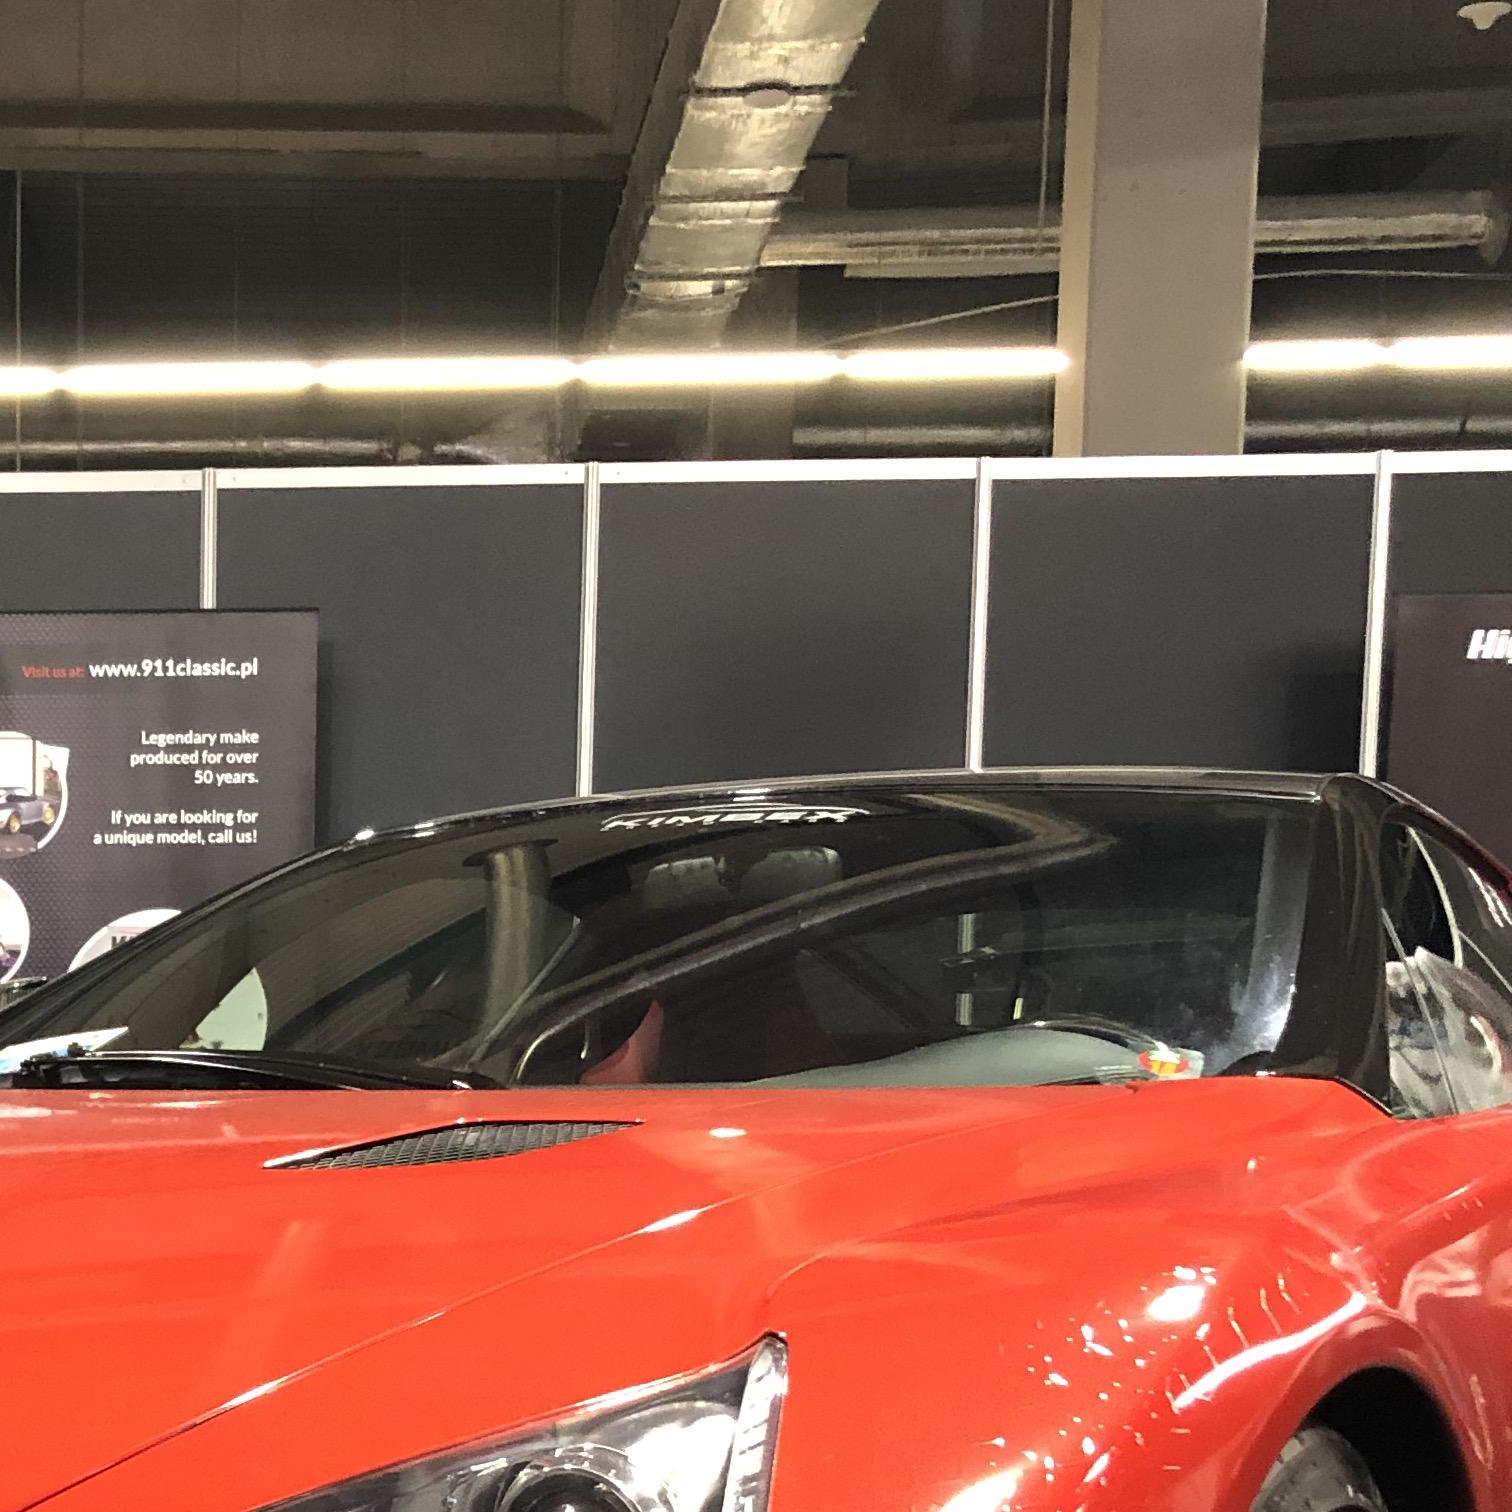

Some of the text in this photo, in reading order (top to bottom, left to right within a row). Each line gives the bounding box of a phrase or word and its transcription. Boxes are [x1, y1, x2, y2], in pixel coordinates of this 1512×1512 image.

[22, 665, 50, 679] Visit
[52, 667, 67, 679] us
[88, 657, 259, 679] www.911classic.pl
[141, 729, 259, 747] Legendary make
[130, 750, 259, 767] produced for over
[194, 770, 259, 787] 50 years.
[111, 809, 259, 827] If you are looking for
[93, 829, 258, 847] a unique model, call us!
